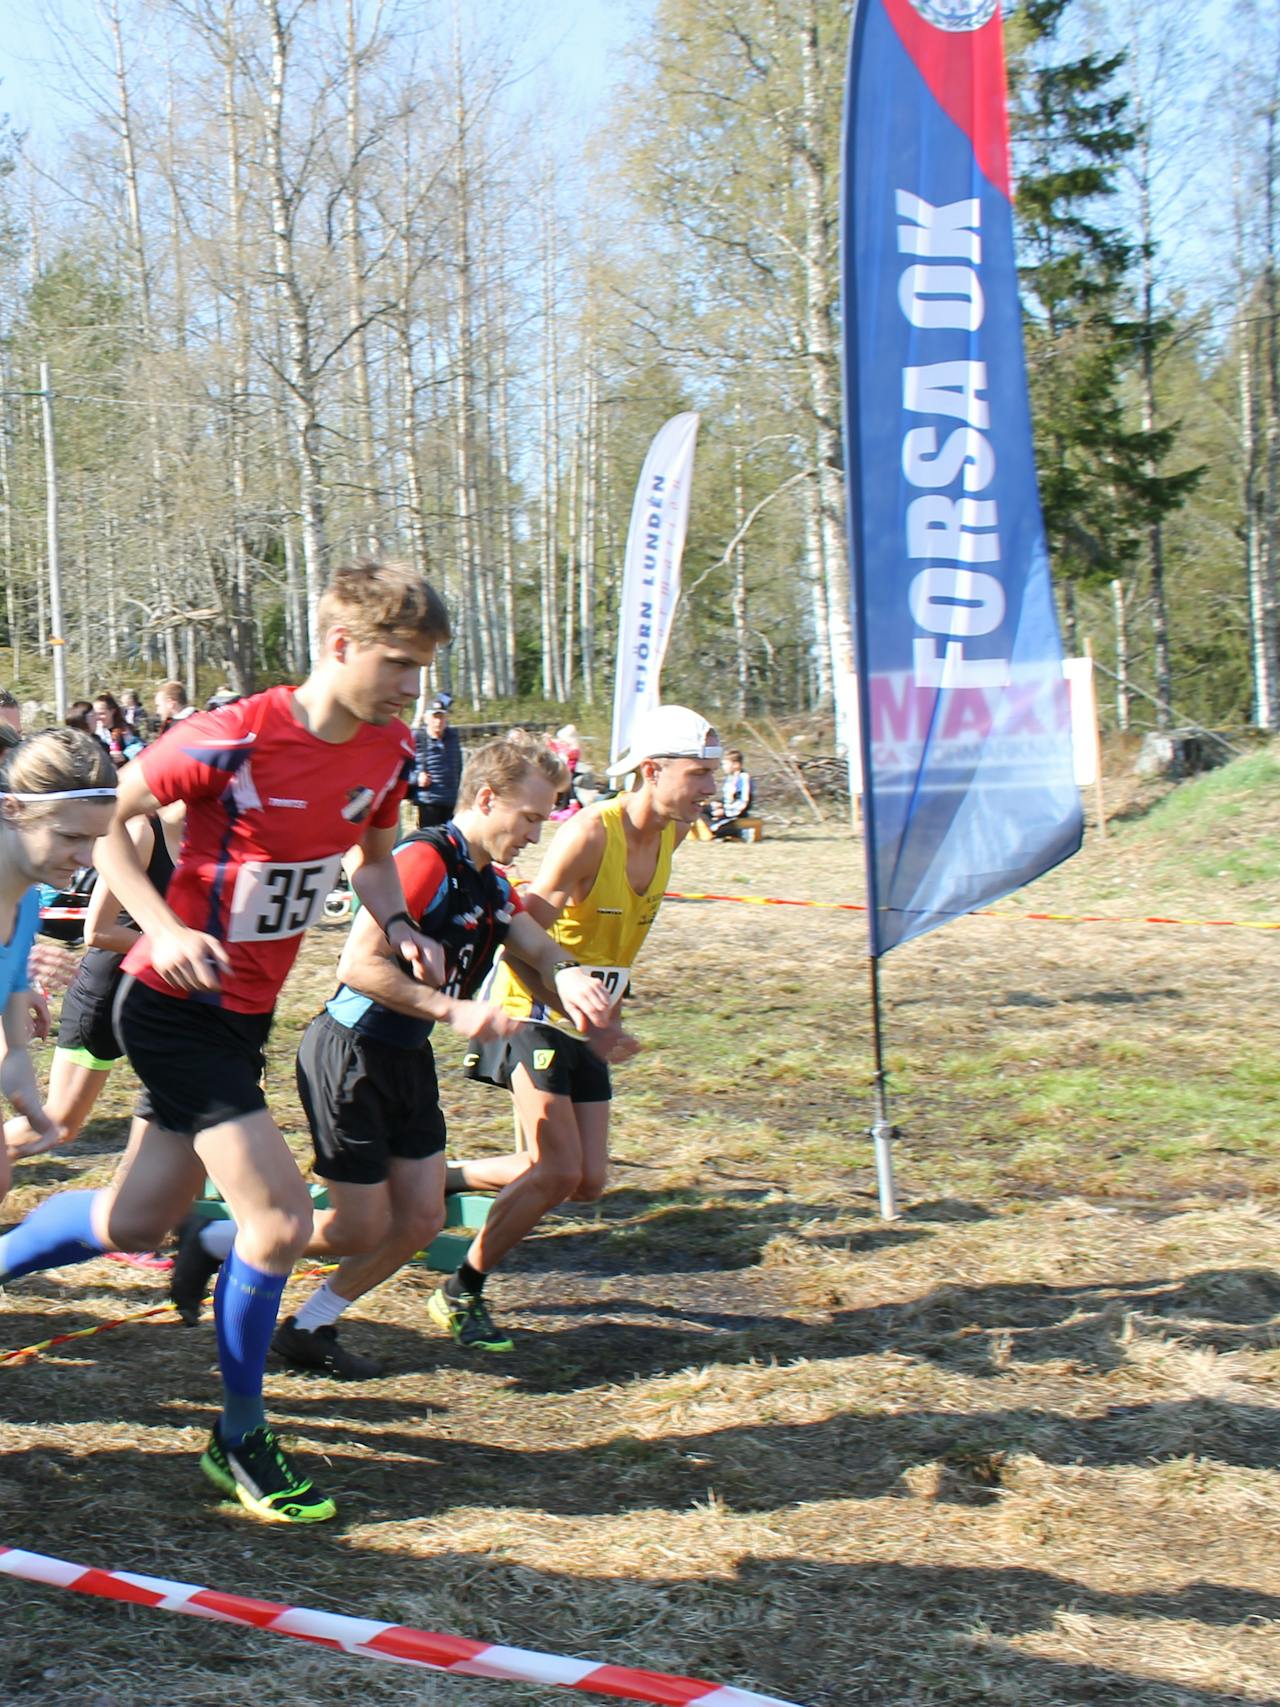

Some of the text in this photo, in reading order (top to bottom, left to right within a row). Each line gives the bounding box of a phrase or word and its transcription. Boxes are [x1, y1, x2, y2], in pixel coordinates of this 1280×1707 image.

[895, 188, 1010, 688] FORSA OK
[256, 866, 324, 934] 35
